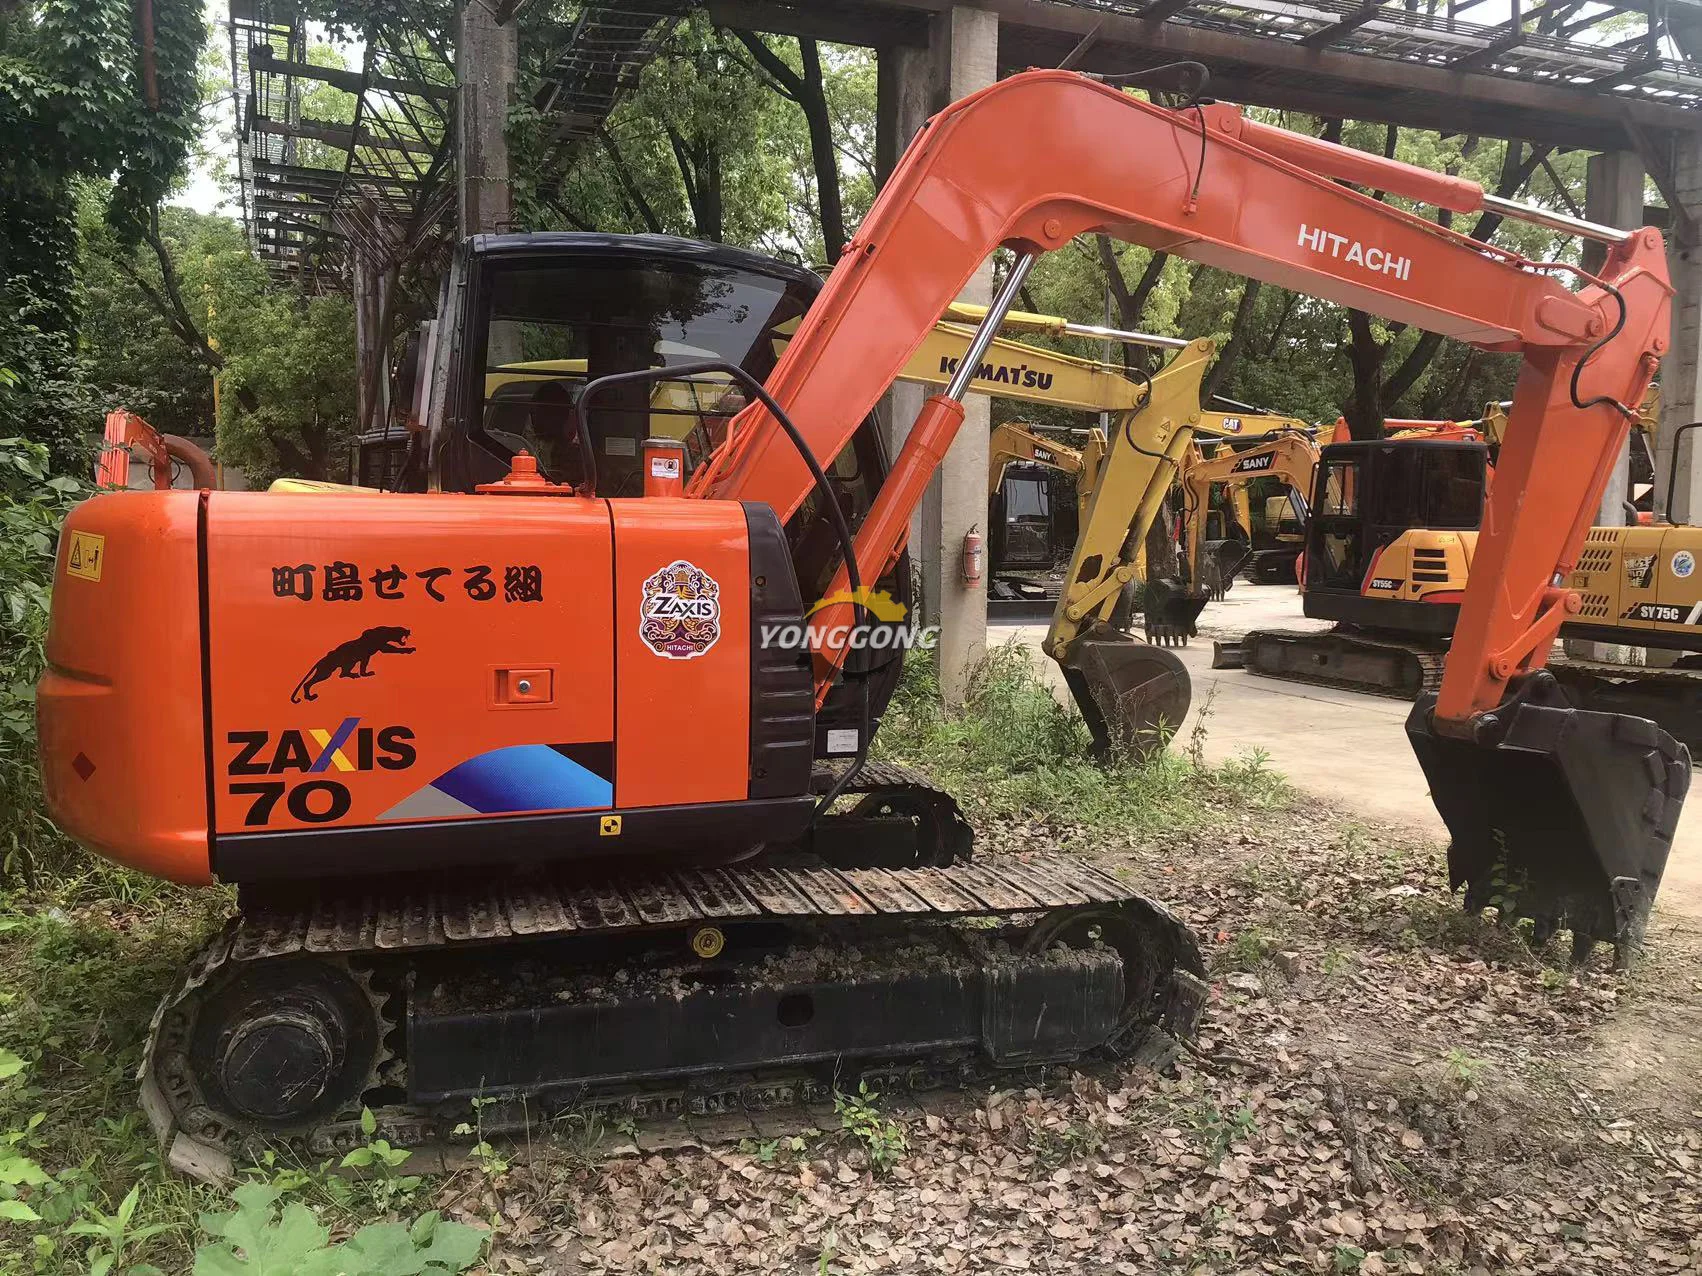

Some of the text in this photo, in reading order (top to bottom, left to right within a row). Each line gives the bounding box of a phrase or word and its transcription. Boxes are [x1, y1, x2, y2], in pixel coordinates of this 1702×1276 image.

[1297, 223, 1411, 281] HITACHI
[939, 356, 1053, 390] KMATSU
[1223, 417, 1239, 430] CAT
[1034, 448, 1052, 461] SANY
[1242, 456, 1270, 470] SANY
[271, 561, 544, 602] 町島せてる組
[1372, 579, 1393, 589] SY55C
[652, 595, 713, 617] ZAXIS
[227, 717, 417, 776] ZAXIS
[228, 780, 352, 826] 70
